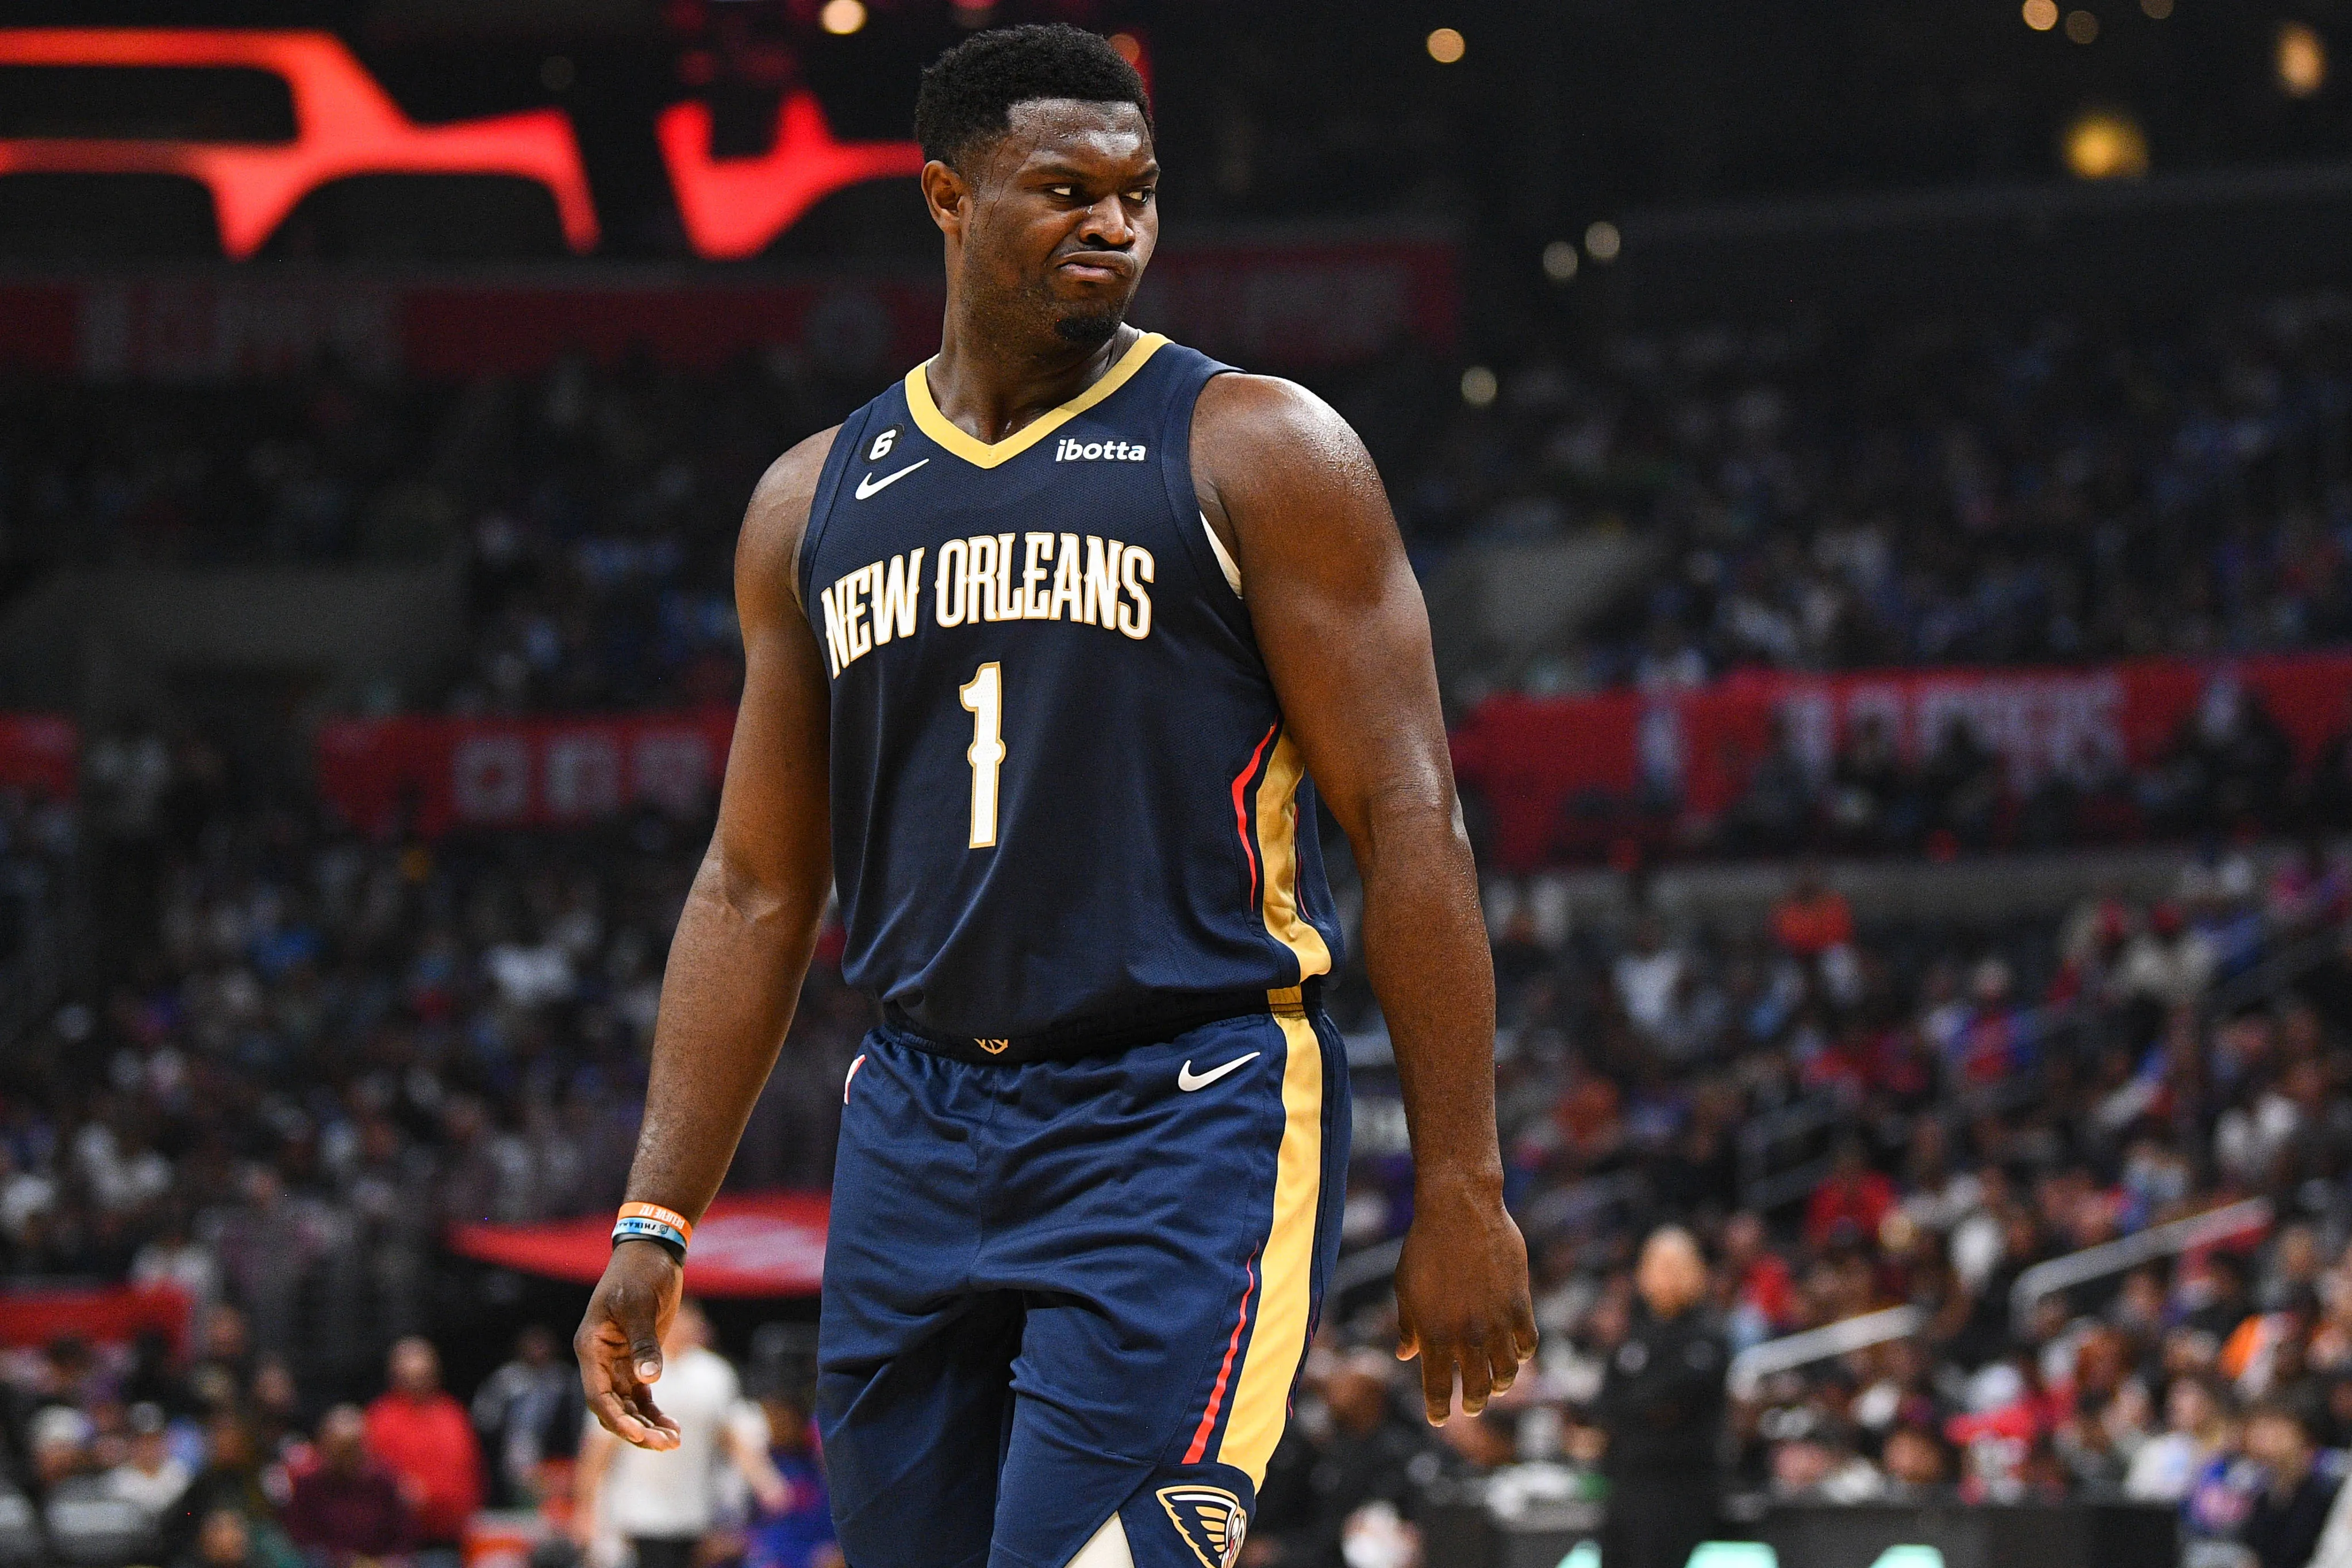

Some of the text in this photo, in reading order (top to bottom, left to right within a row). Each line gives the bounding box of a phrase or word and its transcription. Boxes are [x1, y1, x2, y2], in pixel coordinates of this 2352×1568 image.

[869, 429, 897, 460] 6
[1055, 438, 1146, 462] ibotta
[821, 532, 1154, 679] NEW ORLEANS
[959, 661, 1006, 849] 1
